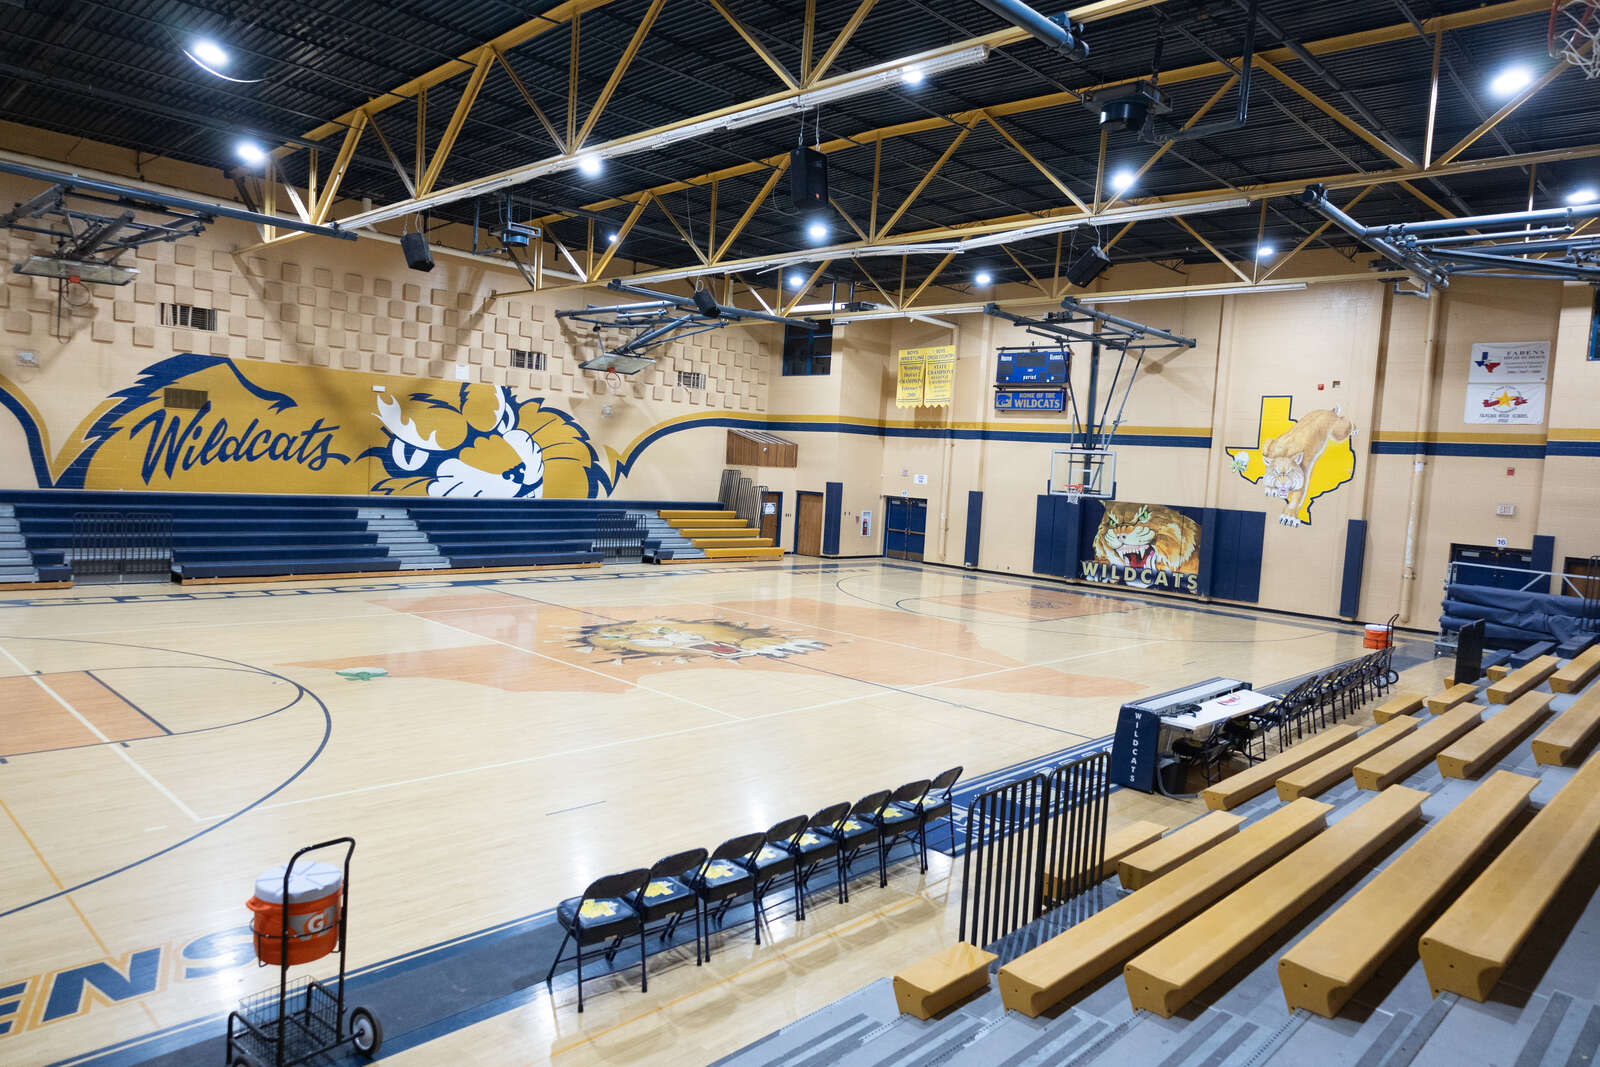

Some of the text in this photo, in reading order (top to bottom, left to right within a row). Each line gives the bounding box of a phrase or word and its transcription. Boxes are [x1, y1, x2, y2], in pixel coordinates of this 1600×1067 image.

[1014, 399, 1060, 408] WILDCATS
[129, 400, 351, 486] Wildcats
[1082, 561, 1198, 590] WILDCATS
[0, 582, 452, 607] COUNTR
[1129, 712, 1143, 782] WILDCATS
